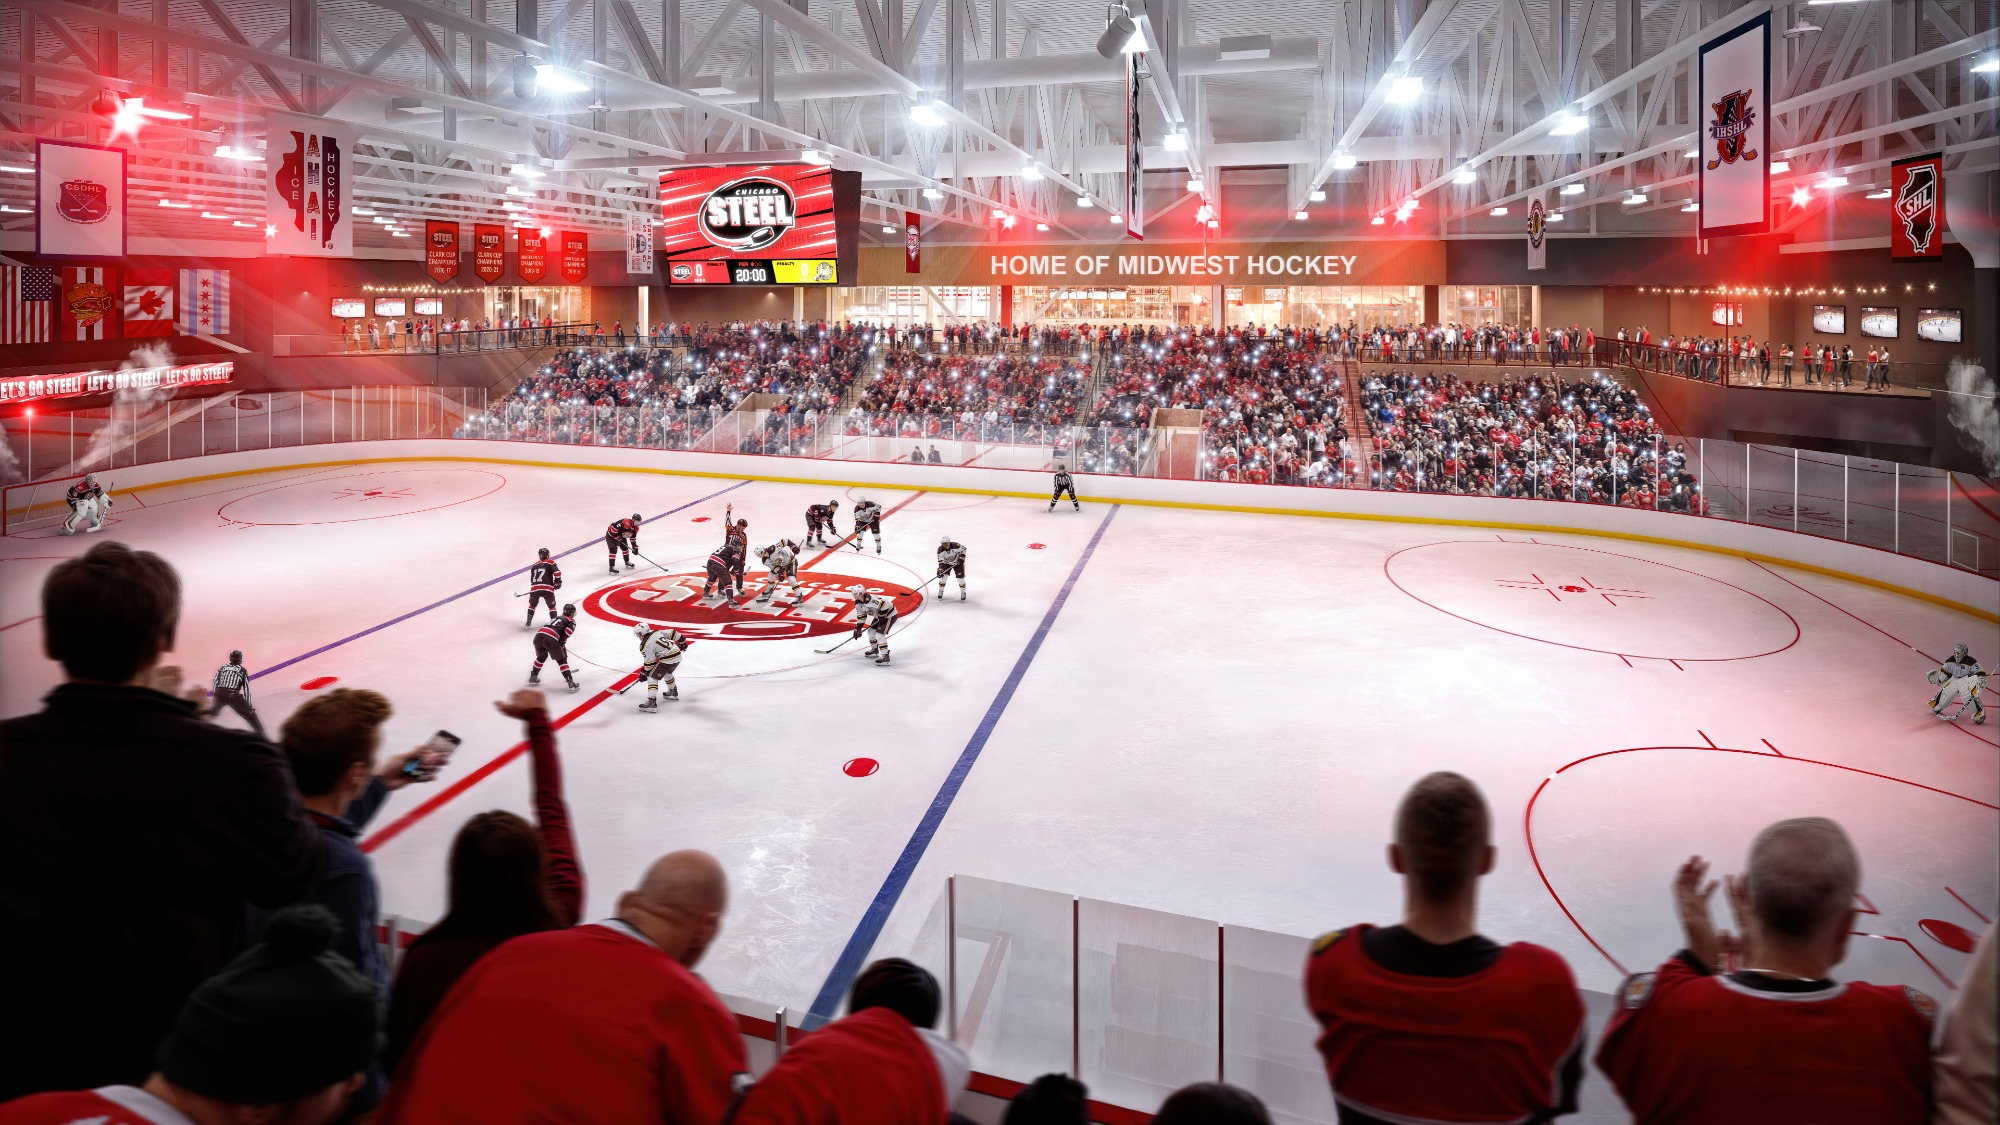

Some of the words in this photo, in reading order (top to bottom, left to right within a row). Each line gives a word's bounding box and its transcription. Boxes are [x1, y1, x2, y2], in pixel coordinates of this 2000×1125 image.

[1716, 120, 1747, 138] IHSHL
[65, 183, 102, 193] CSDHL
[291, 165, 300, 200] ICE
[307, 134, 320, 240] AHAI
[327, 153, 336, 222] HOCKEY
[707, 195, 793, 227] STEEL
[1905, 188, 1931, 216] SHL
[433, 232, 453, 243] STEEL
[481, 234, 499, 244] STEEL
[525, 239, 541, 247] STEEL
[567, 242, 583, 250] STEEL
[695, 264, 703, 277] 0
[801, 263, 809, 277] 0
[991, 255, 1067, 275] HOME
[1075, 255, 1110, 275] OF
[1118, 255, 1240, 275] MIDWEST
[1248, 255, 1357, 275] HOCKEY
[735, 268, 767, 282] 20:00
[87, 374, 114, 391] LET'S
[131, 370, 160, 388] STEEL!
[166, 368, 189, 384] LET'S
[202, 366, 229, 380] STEEL!
[0, 381, 26, 399] ET'S
[28, 380, 44, 397] GO
[46, 377, 81, 395] STEEL!
[532, 568, 546, 583] 17
